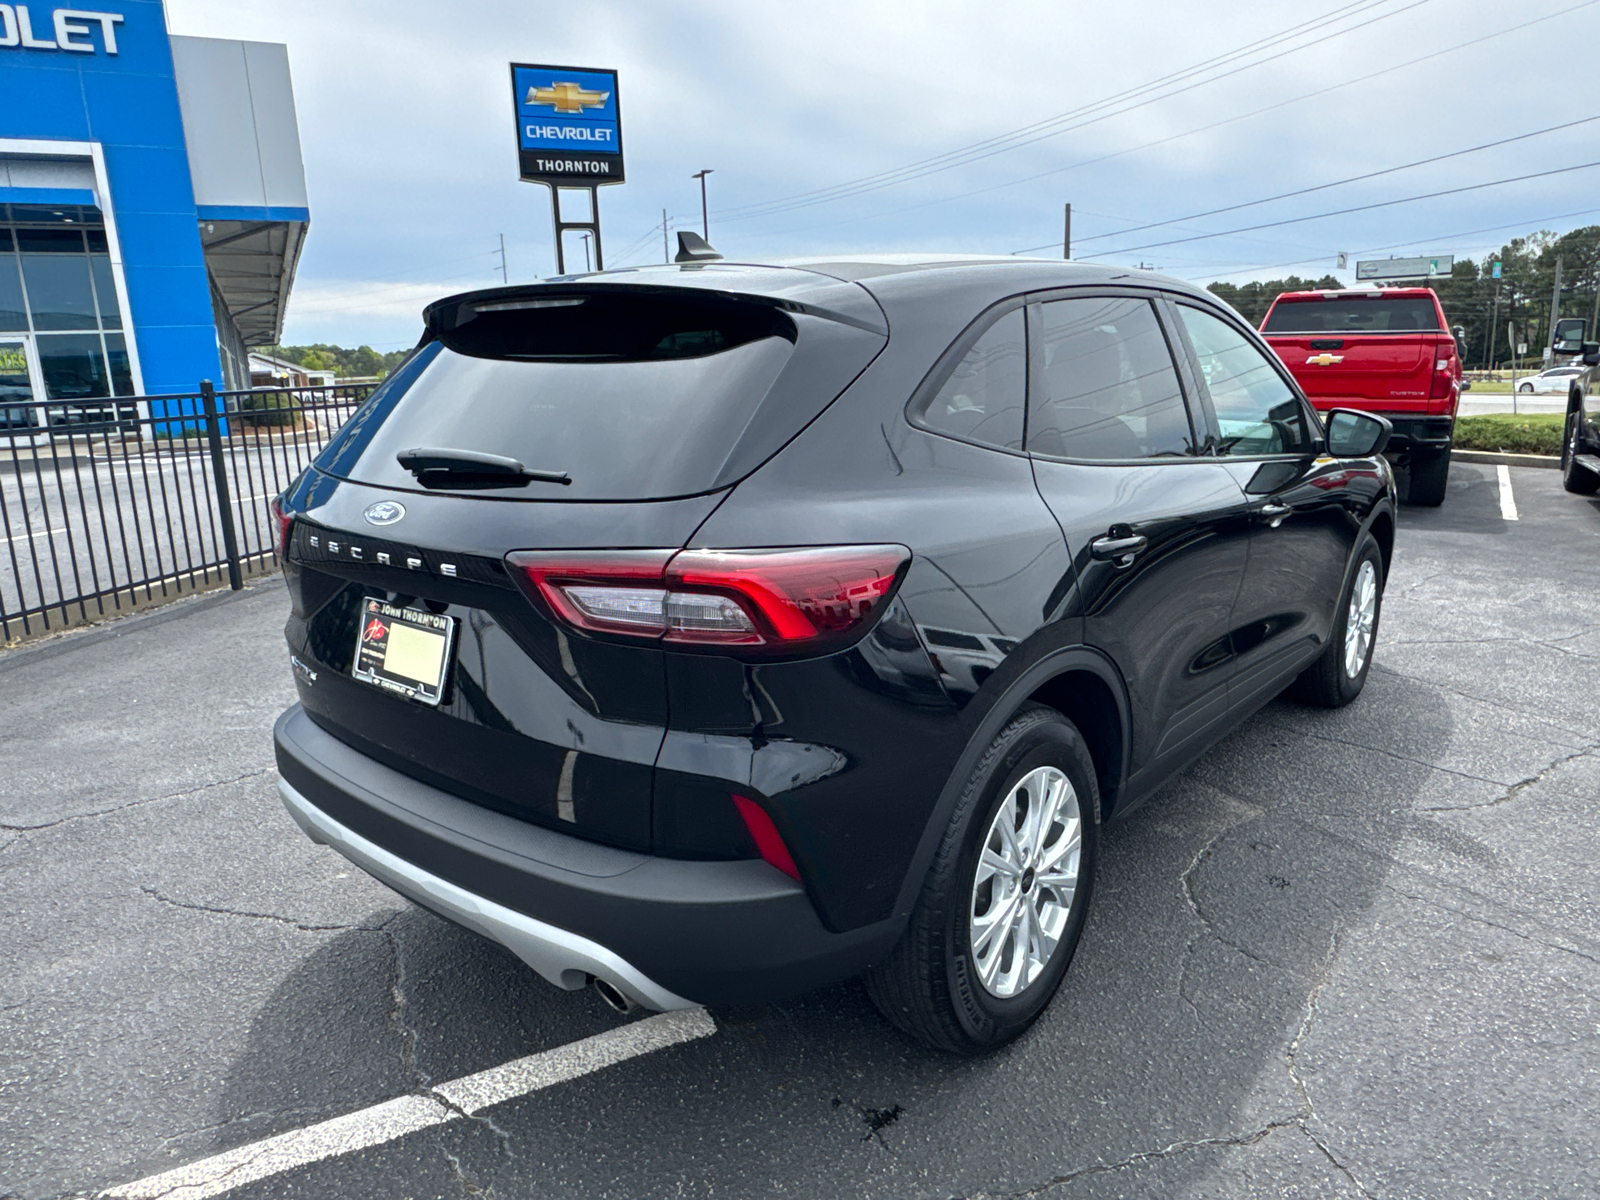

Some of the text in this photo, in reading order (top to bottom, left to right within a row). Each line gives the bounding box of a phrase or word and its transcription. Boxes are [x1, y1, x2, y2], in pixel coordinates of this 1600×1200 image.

[525, 125, 613, 142] CHEVROLET
[536, 159, 609, 173] THORNTON
[0, 353, 27, 369] LES
[369, 504, 393, 520] Ford
[309, 535, 457, 577] ESCAPE
[380, 603, 401, 618] JOHN
[402, 609, 447, 630] THORNTON
[380, 680, 407, 694] CHEVROLET
[955, 959, 984, 1026] MICHELIN
